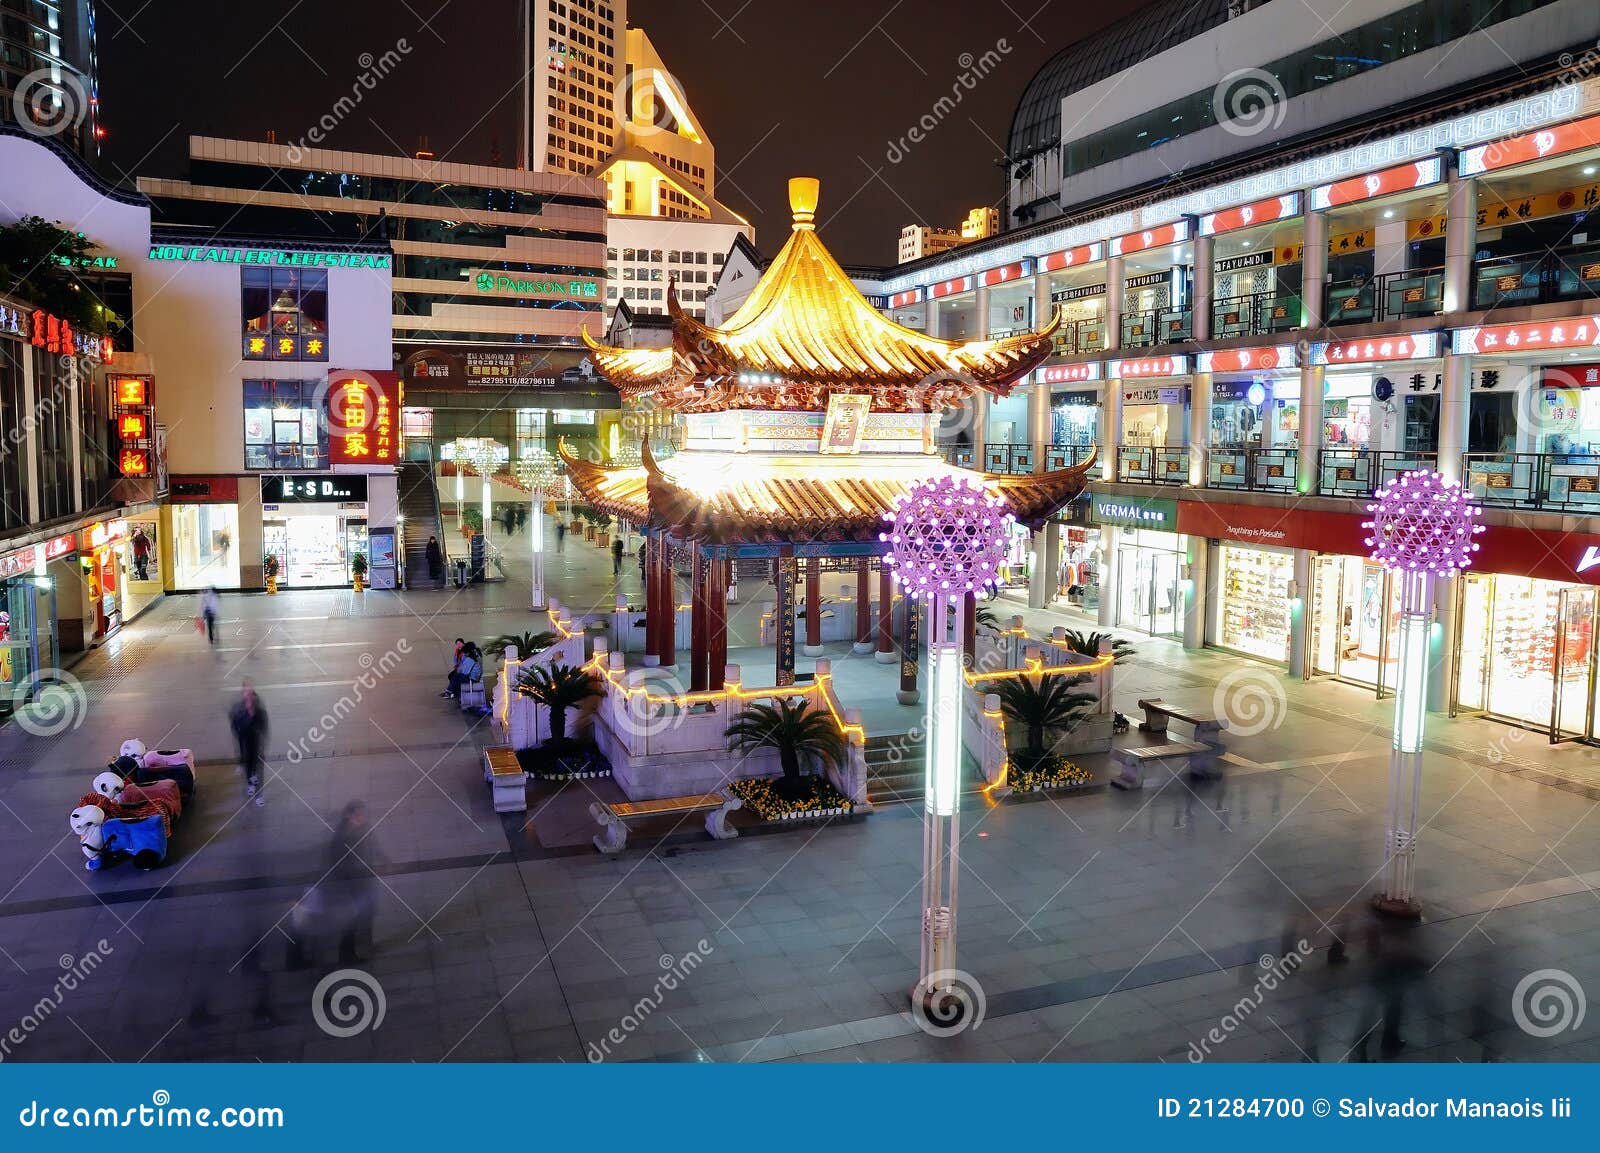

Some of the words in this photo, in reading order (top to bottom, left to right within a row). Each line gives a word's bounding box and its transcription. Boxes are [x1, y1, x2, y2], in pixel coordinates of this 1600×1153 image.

[149, 246, 271, 264] HOUCALLER
[277, 251, 390, 269] BEEFSTEAK
[1222, 255, 1265, 271] FAYUANDI
[497, 276, 566, 295] PARKSON
[342, 379, 369, 457] 吉田家
[1098, 503, 1142, 519] VERMAL
[1226, 525, 1252, 538] Anything
[1259, 528, 1286, 539] Possible
